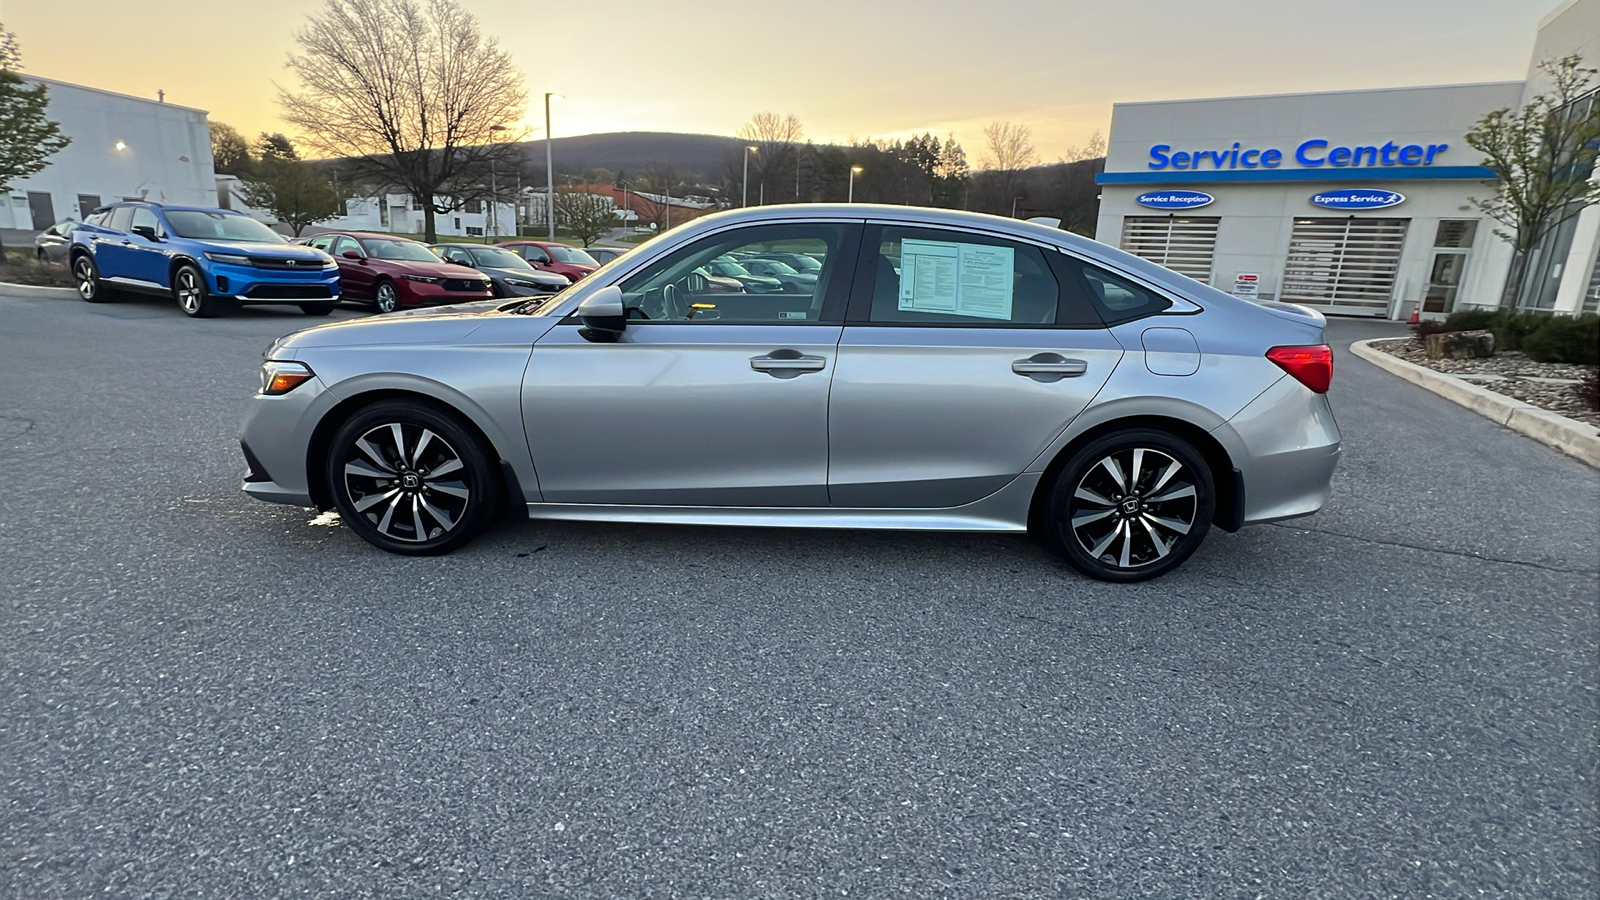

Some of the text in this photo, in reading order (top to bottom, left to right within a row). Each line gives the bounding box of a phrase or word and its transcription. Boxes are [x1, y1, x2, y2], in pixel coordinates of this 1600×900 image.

[1148, 139, 1448, 170] Service Center
[1140, 195, 1209, 204] Service Reception
[1314, 194, 1384, 204] Express Service
